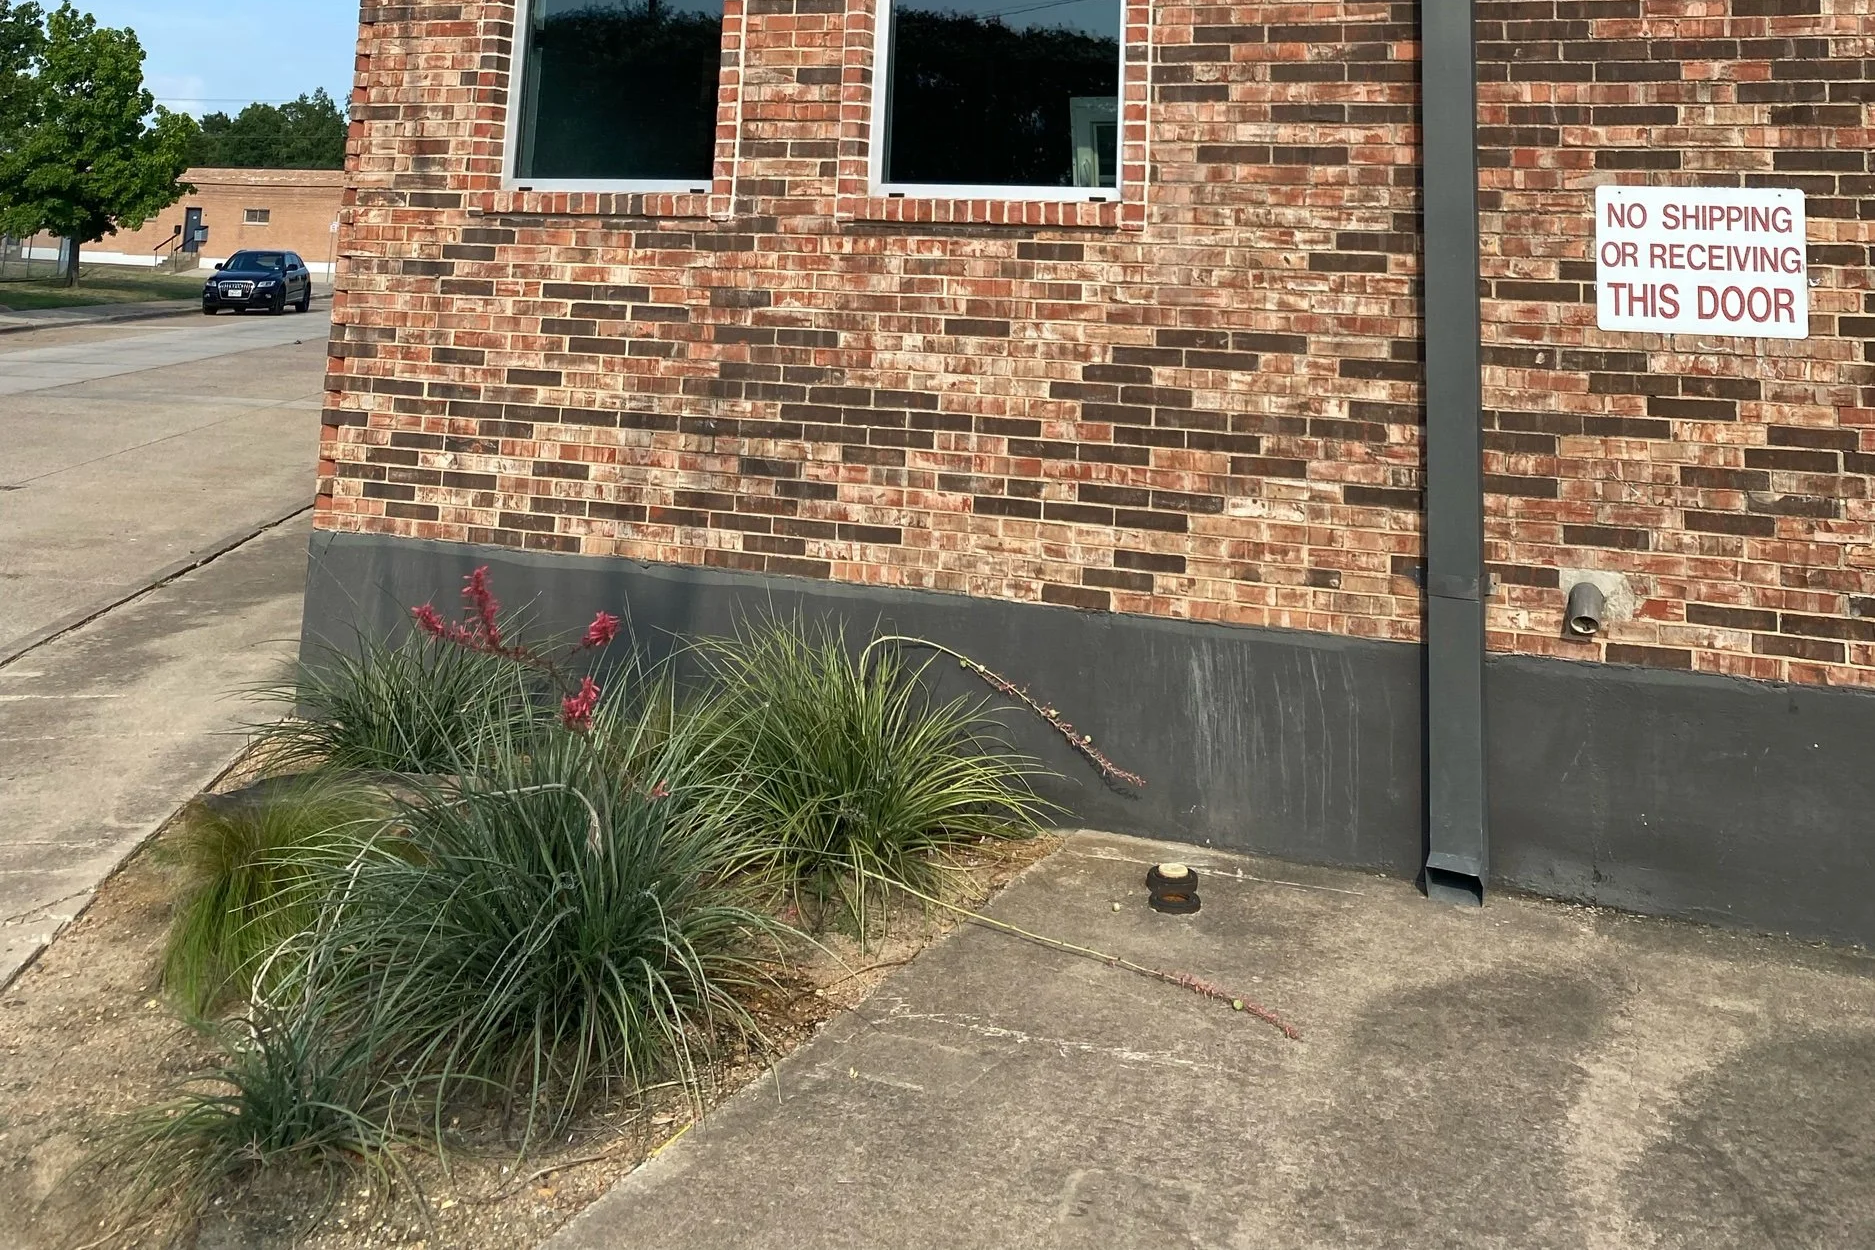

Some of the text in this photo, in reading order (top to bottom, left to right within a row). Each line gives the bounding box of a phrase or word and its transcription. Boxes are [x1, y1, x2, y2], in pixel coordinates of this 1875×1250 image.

[1607, 203, 1792, 233] NO SHIPPING
[1601, 242, 1801, 273] OR RECEIVING
[1607, 283, 1795, 323] THIS DOOR
